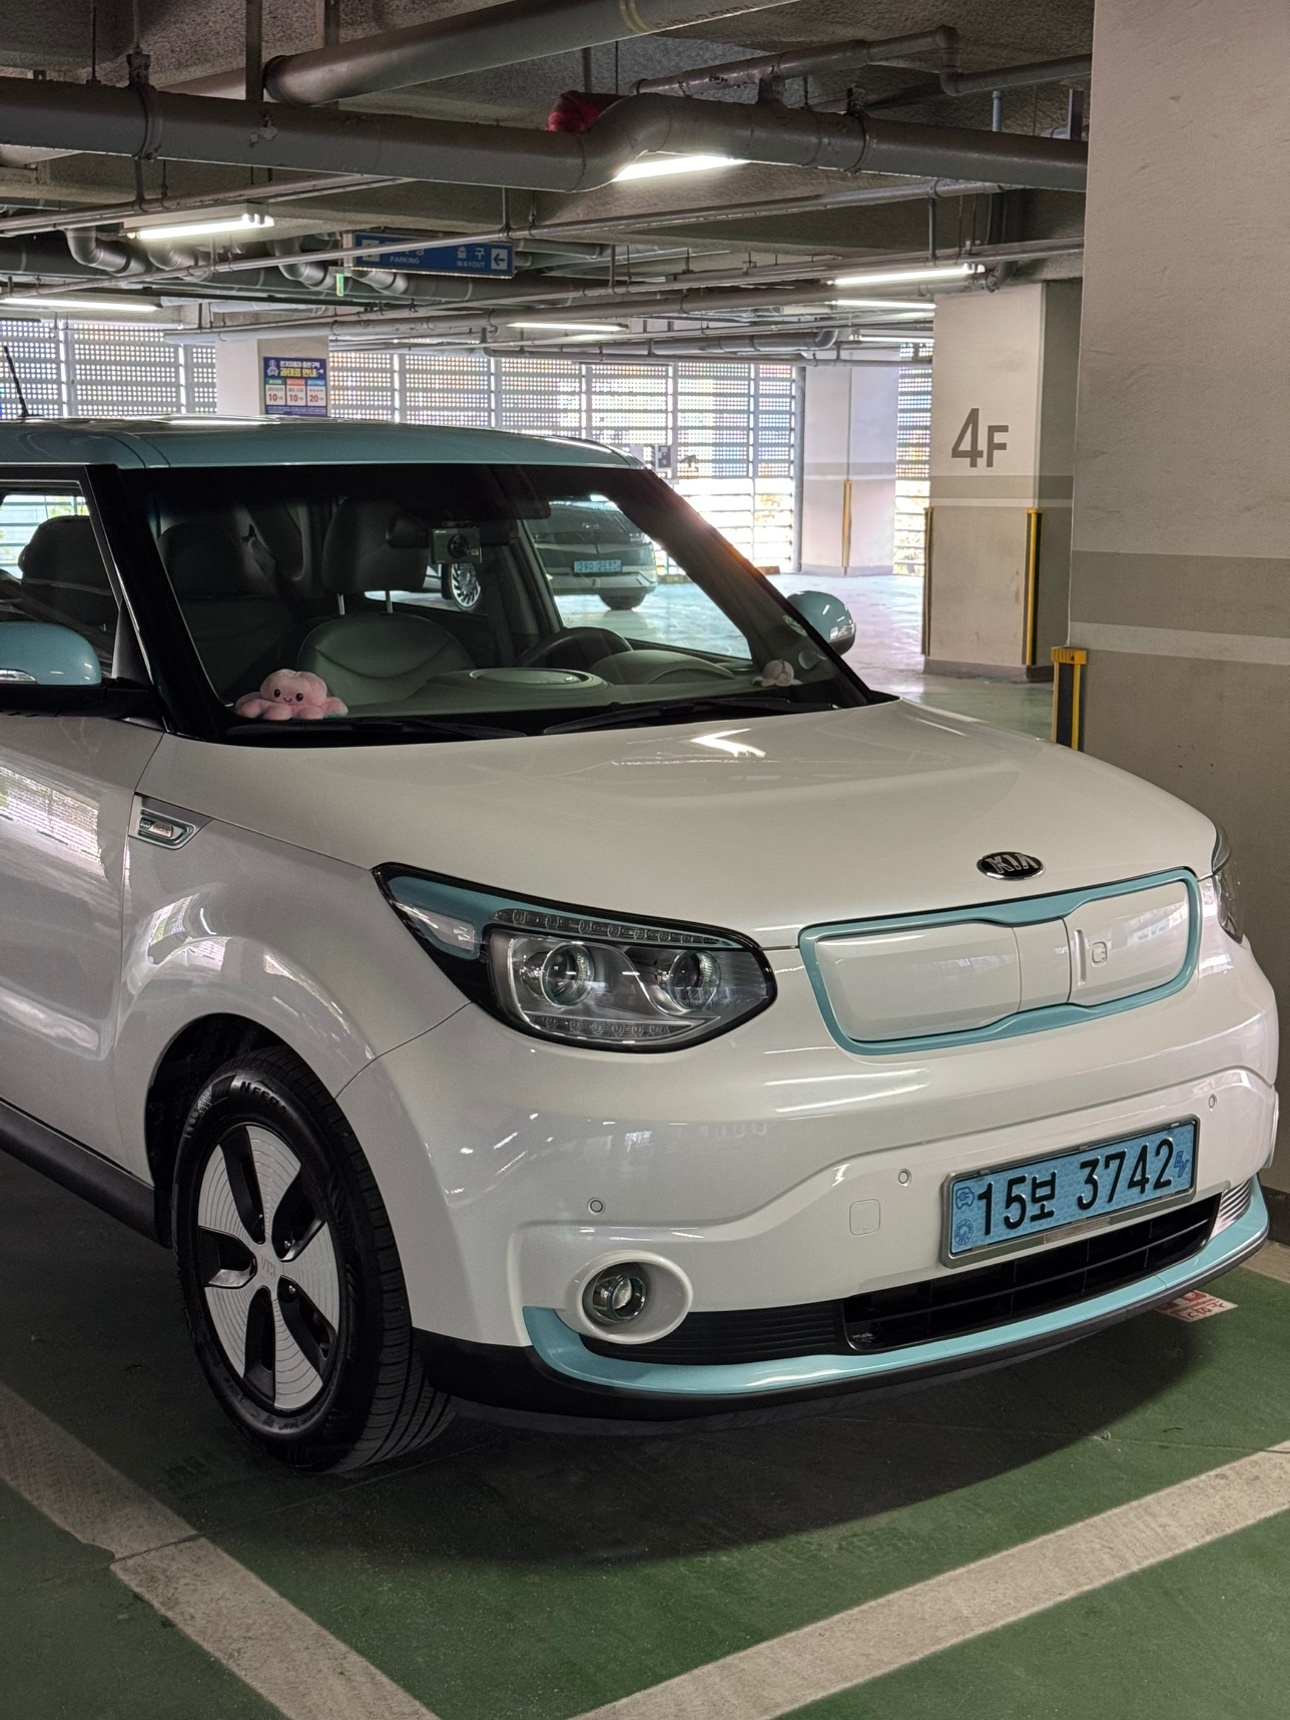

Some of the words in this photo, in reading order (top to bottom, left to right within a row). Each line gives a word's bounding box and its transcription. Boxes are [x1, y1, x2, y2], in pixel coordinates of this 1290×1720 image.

[390, 256, 420, 265] PARKING
[457, 246, 485, 260] 출구
[457, 261, 485, 269] WAYOUT
[951, 408, 1009, 468] 4F
[985, 854, 1038, 874] KIA
[977, 1170, 1058, 1236] 15보
[1077, 1136, 1175, 1211] 3742
